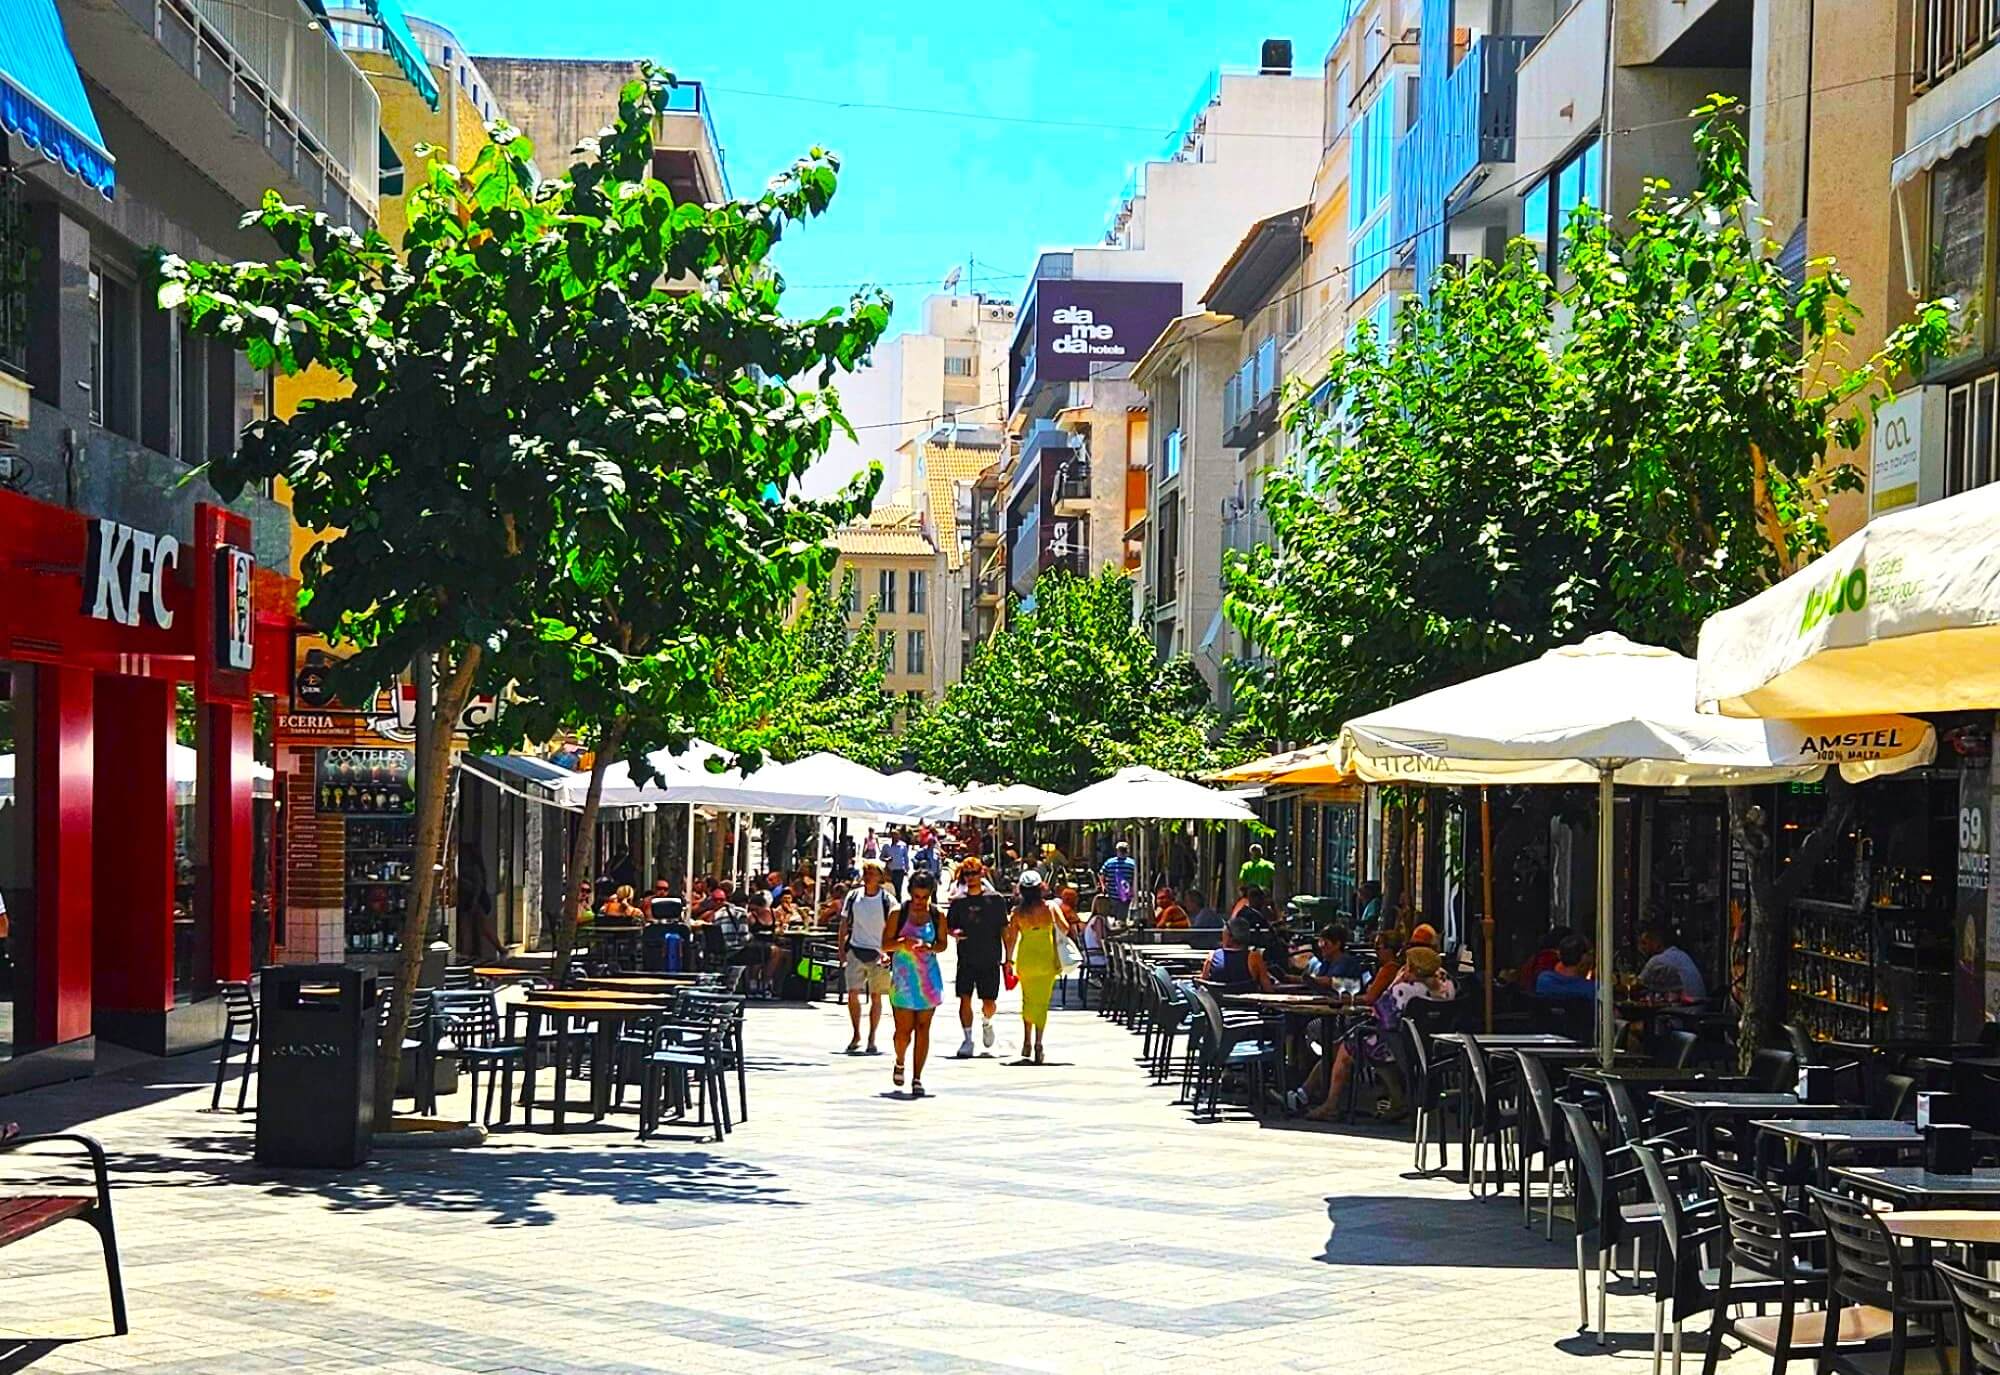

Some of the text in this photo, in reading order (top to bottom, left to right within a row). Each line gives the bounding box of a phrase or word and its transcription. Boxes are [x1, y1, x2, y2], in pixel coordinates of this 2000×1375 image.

[1052, 306, 1093, 324] ala
[1072, 325, 1113, 340] me
[1053, 334, 1125, 355] da hotels
[92, 518, 179, 630] KFC
[1800, 728, 1902, 755] AMSTEL
[328, 749, 406, 761] COCTELES
[1817, 750, 1881, 761] 100% MALTA
[1959, 807, 1981, 849] 69
